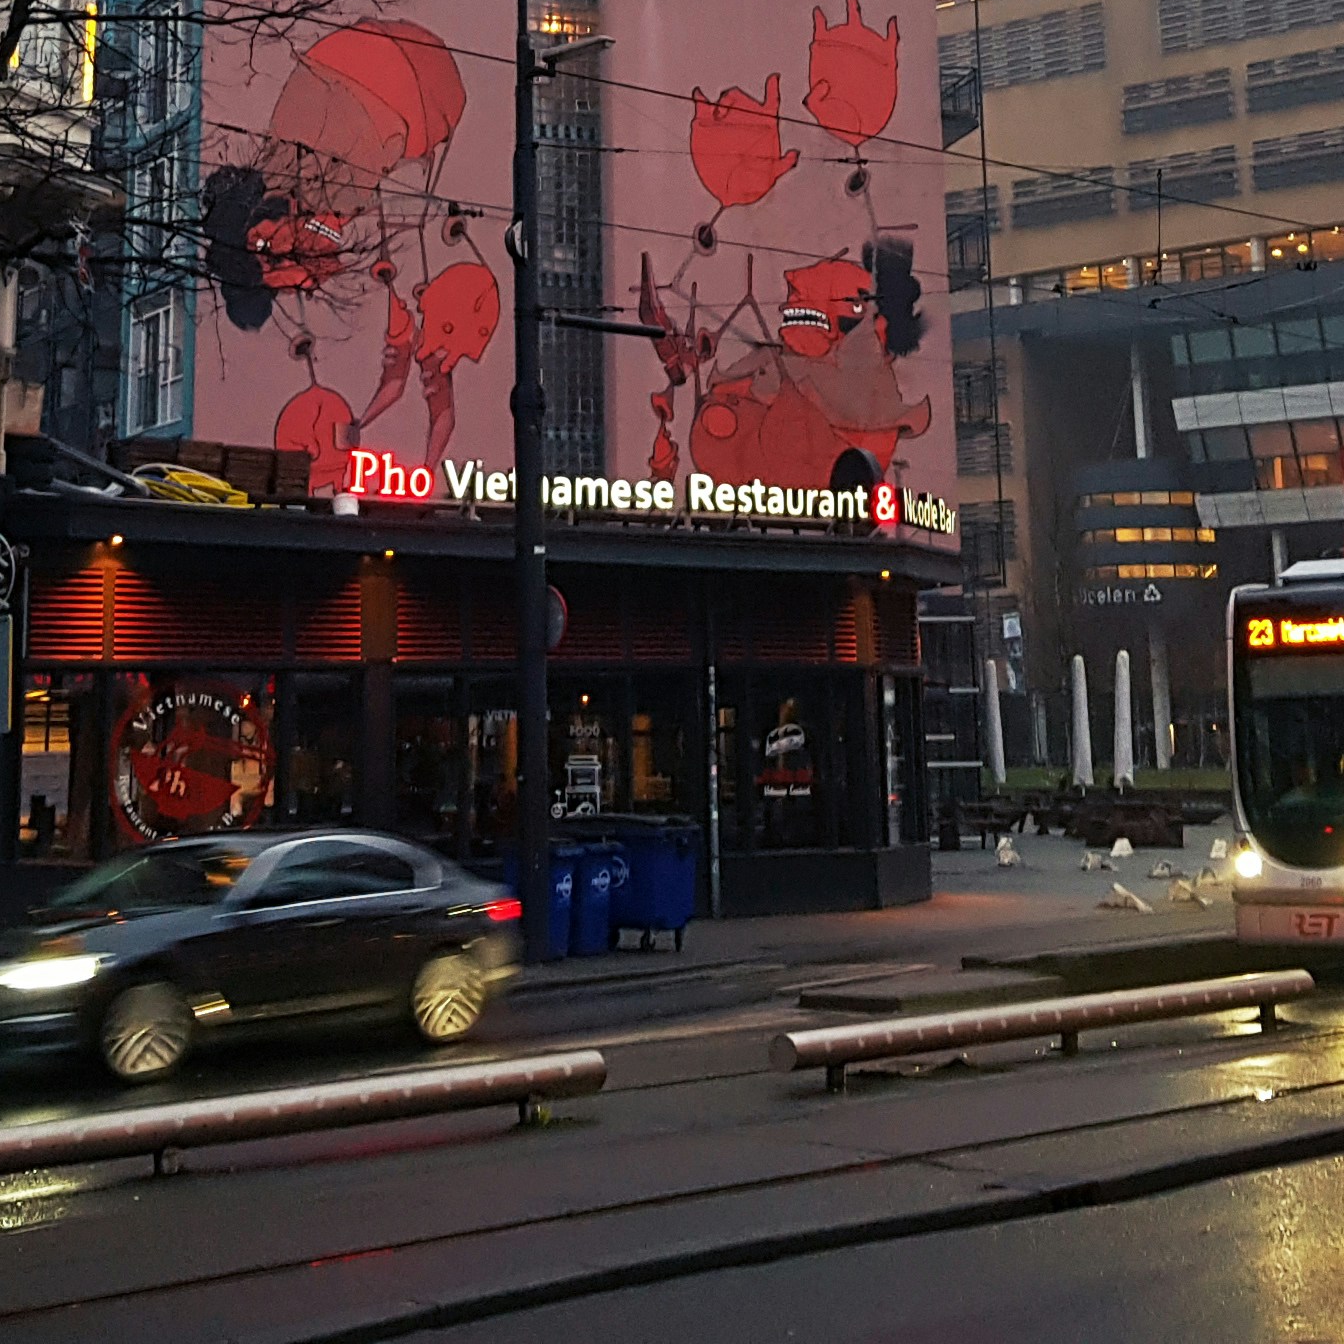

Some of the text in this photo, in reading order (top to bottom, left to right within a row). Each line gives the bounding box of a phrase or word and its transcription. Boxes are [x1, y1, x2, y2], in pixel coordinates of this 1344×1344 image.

[349, 449, 432, 498] Pho
[689, 473, 869, 519] Restaurant
[875, 485, 896, 521] &
[939, 497, 957, 534] Bar
[1248, 619, 1275, 647] 23
[132, 692, 241, 731] Vietnamese
